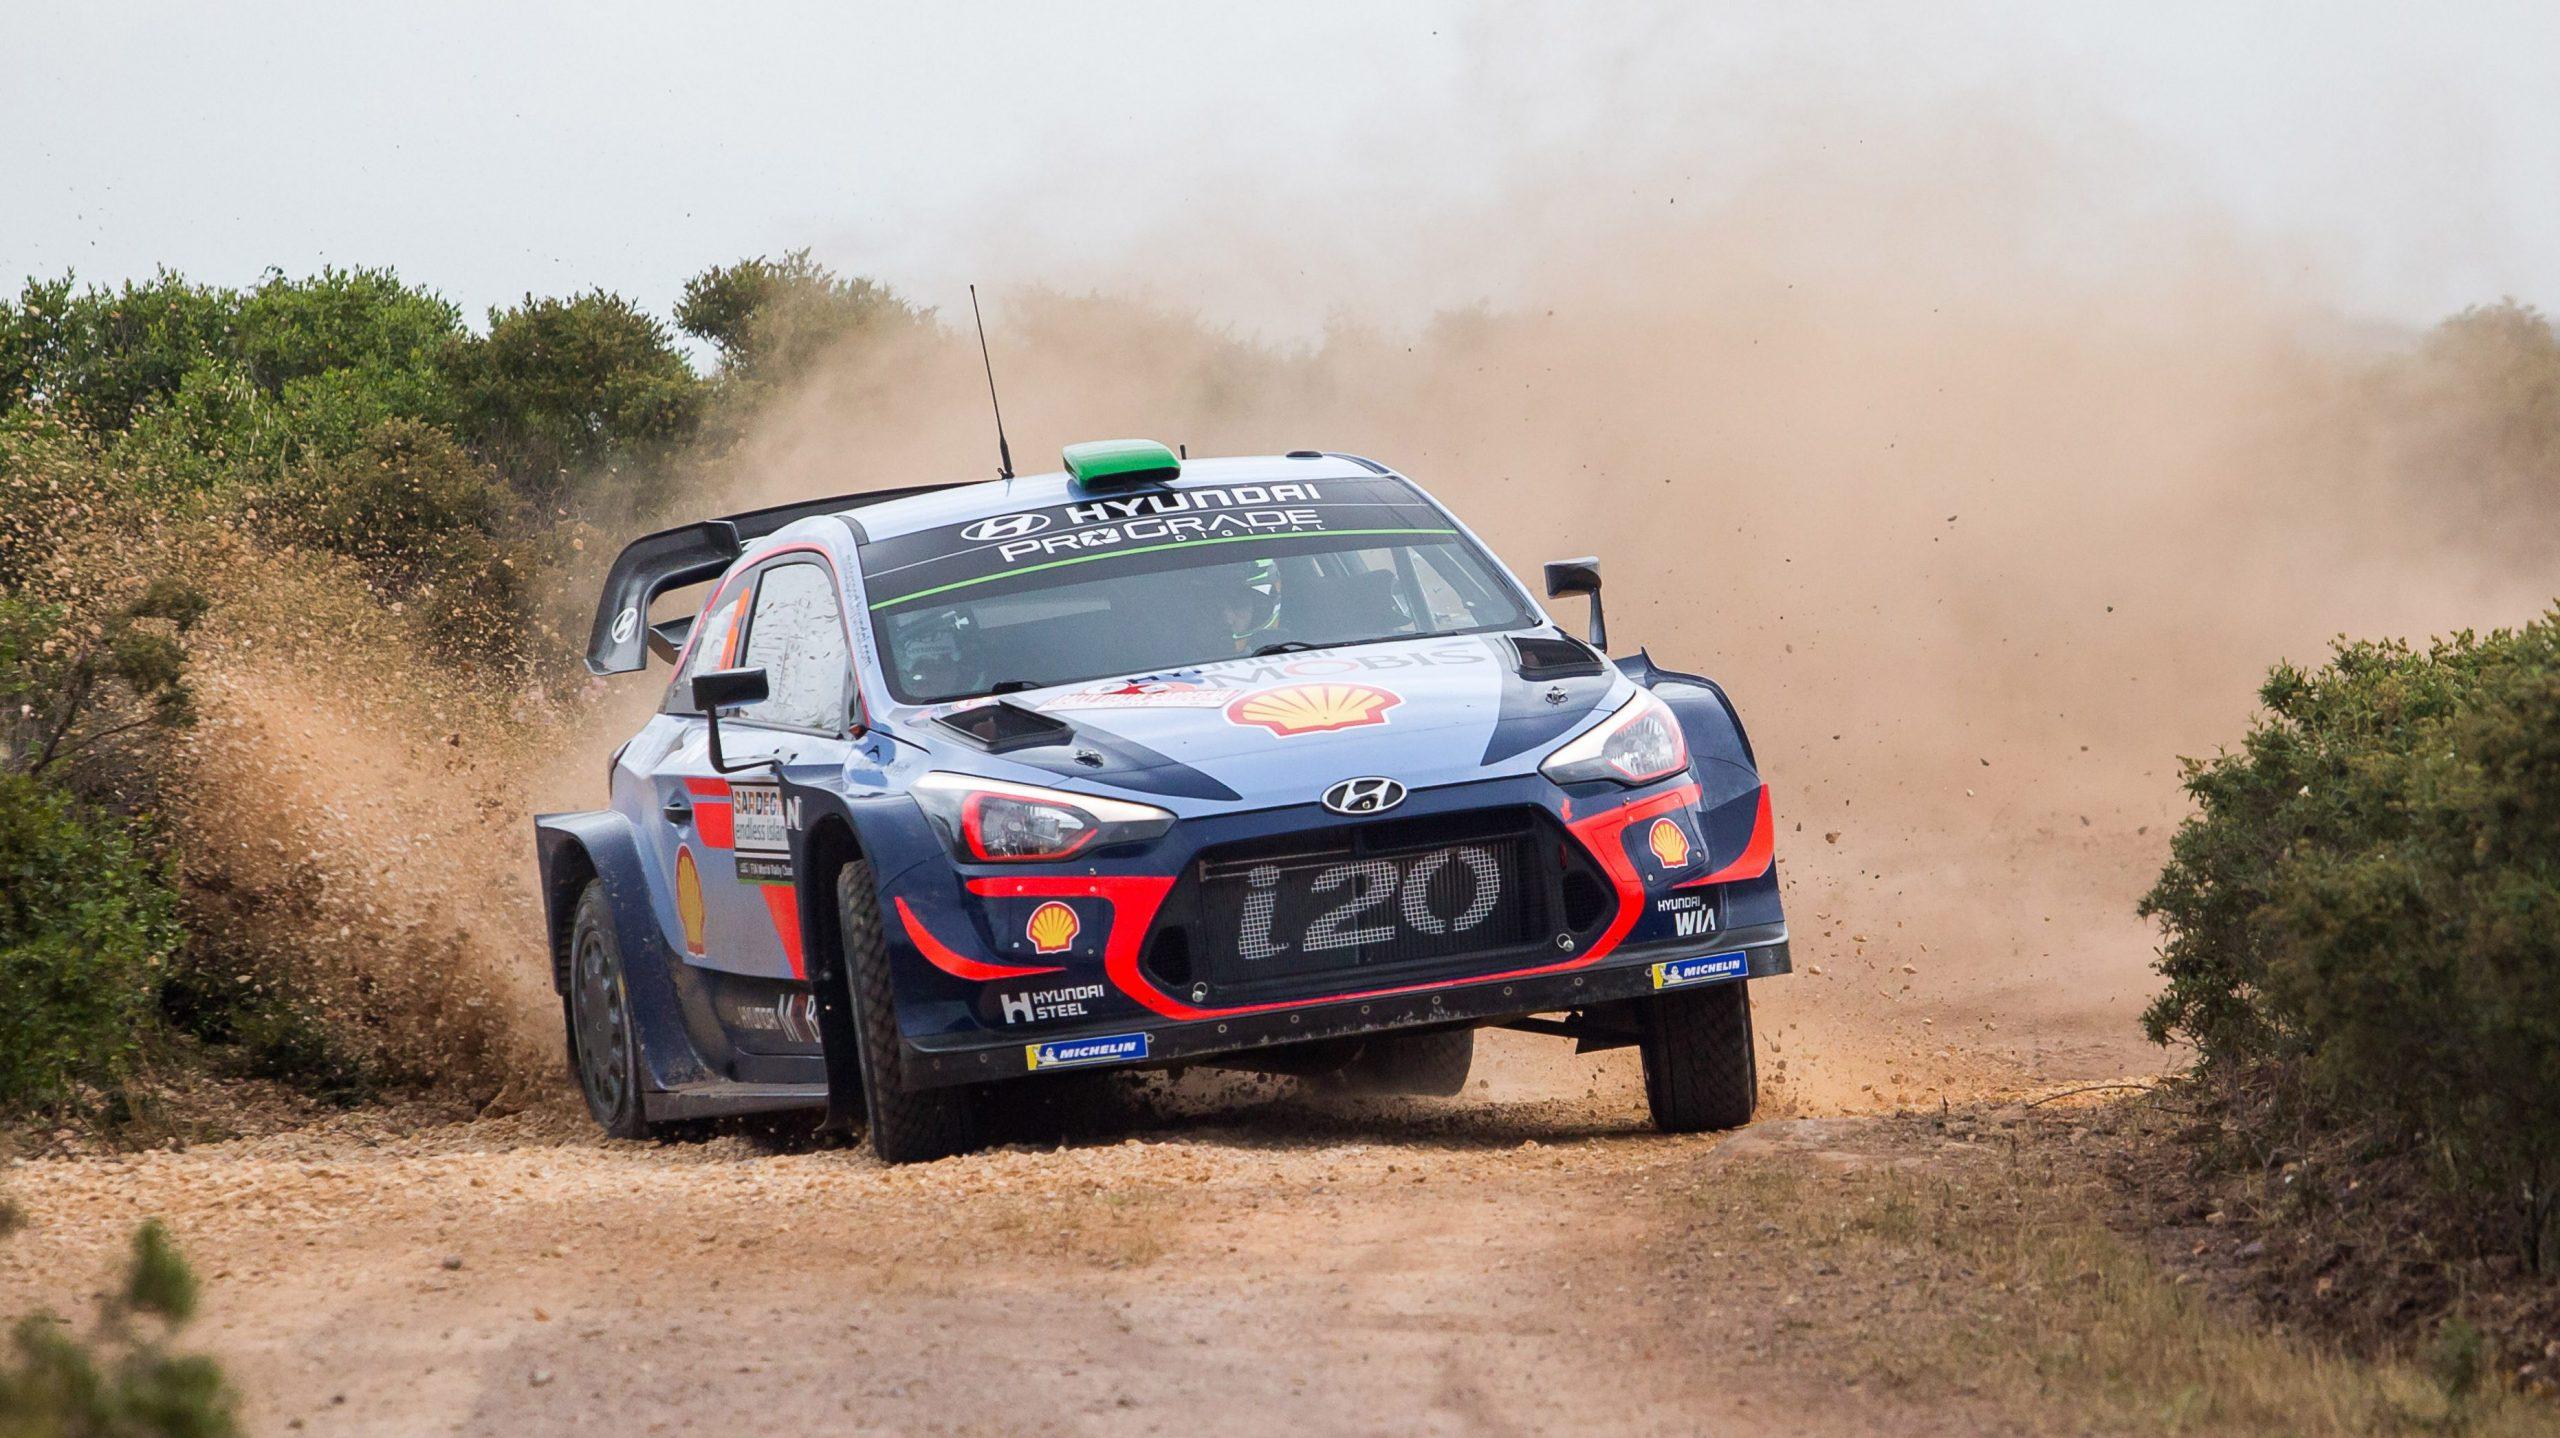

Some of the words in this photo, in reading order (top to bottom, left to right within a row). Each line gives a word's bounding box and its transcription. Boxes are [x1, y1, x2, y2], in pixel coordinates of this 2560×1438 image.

[1064, 483, 1322, 525] HYUNDAI
[1175, 522, 1328, 543] DIGITAL
[1204, 649, 1488, 690] MOBIS
[1237, 845, 1501, 960] i20
[1657, 896, 1701, 912] HYUNDAI
[1683, 959, 1741, 978] MICHELIN
[1031, 984, 1105, 1005] HYUNDAI
[1036, 1002, 1089, 1020] STEEL
[1059, 1041, 1137, 1060] MICHELIN
